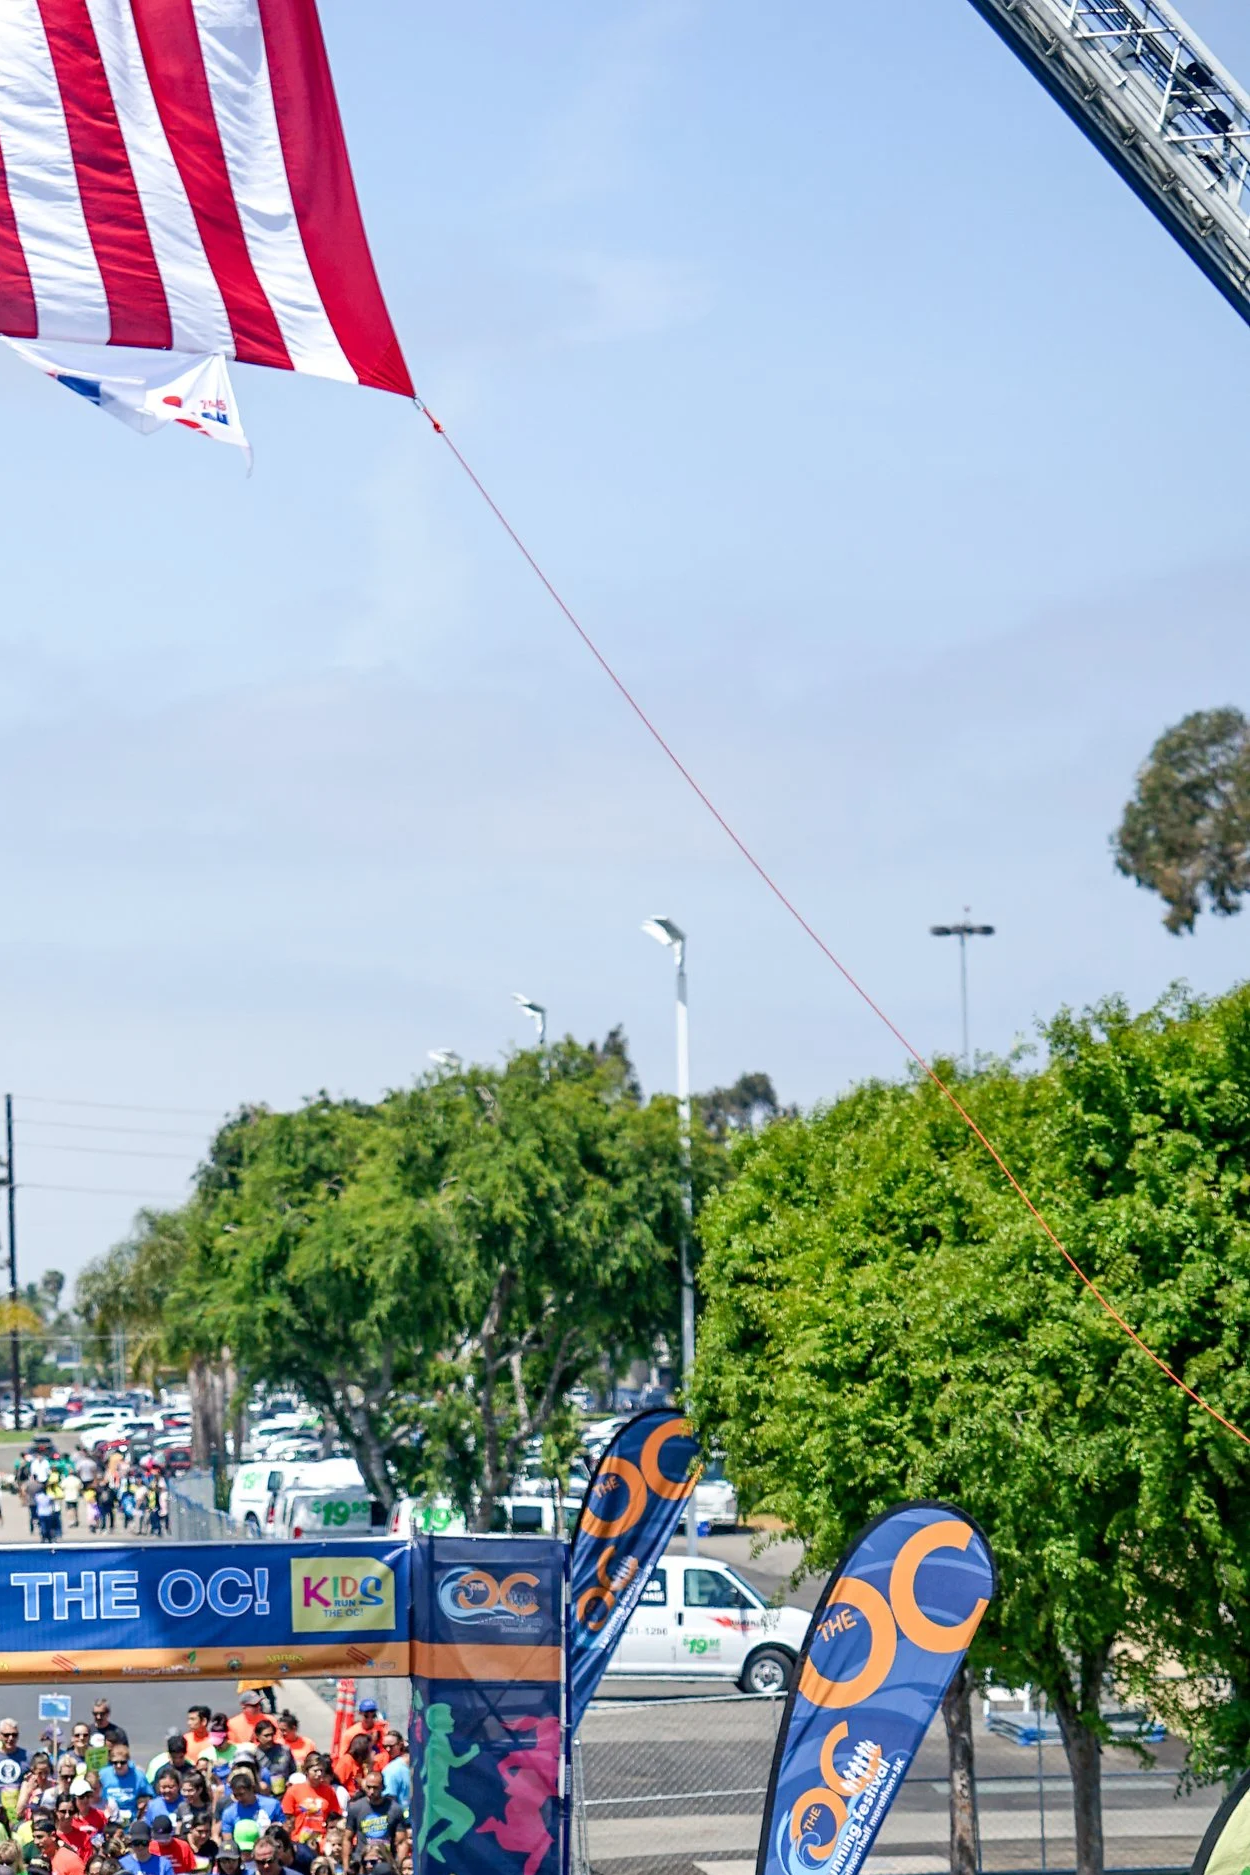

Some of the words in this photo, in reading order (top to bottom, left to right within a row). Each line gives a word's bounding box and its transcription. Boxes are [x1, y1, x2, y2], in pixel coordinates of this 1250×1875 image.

[593, 1476, 620, 1498] THE
[10, 1570, 140, 1621] THE
[157, 1567, 271, 1617] OC!
[303, 1576, 382, 1607] KIDS
[458, 1571, 540, 1615] OC
[470, 1583, 486, 1592] THE
[323, 1609, 343, 1618] THE
[344, 1608, 364, 1617] OC!
[334, 1599, 356, 1608] RUN
[798, 1520, 989, 1709] OC
[816, 1608, 857, 1643] THE
[853, 1757, 891, 1822] festival
[804, 1806, 822, 1831] THE
